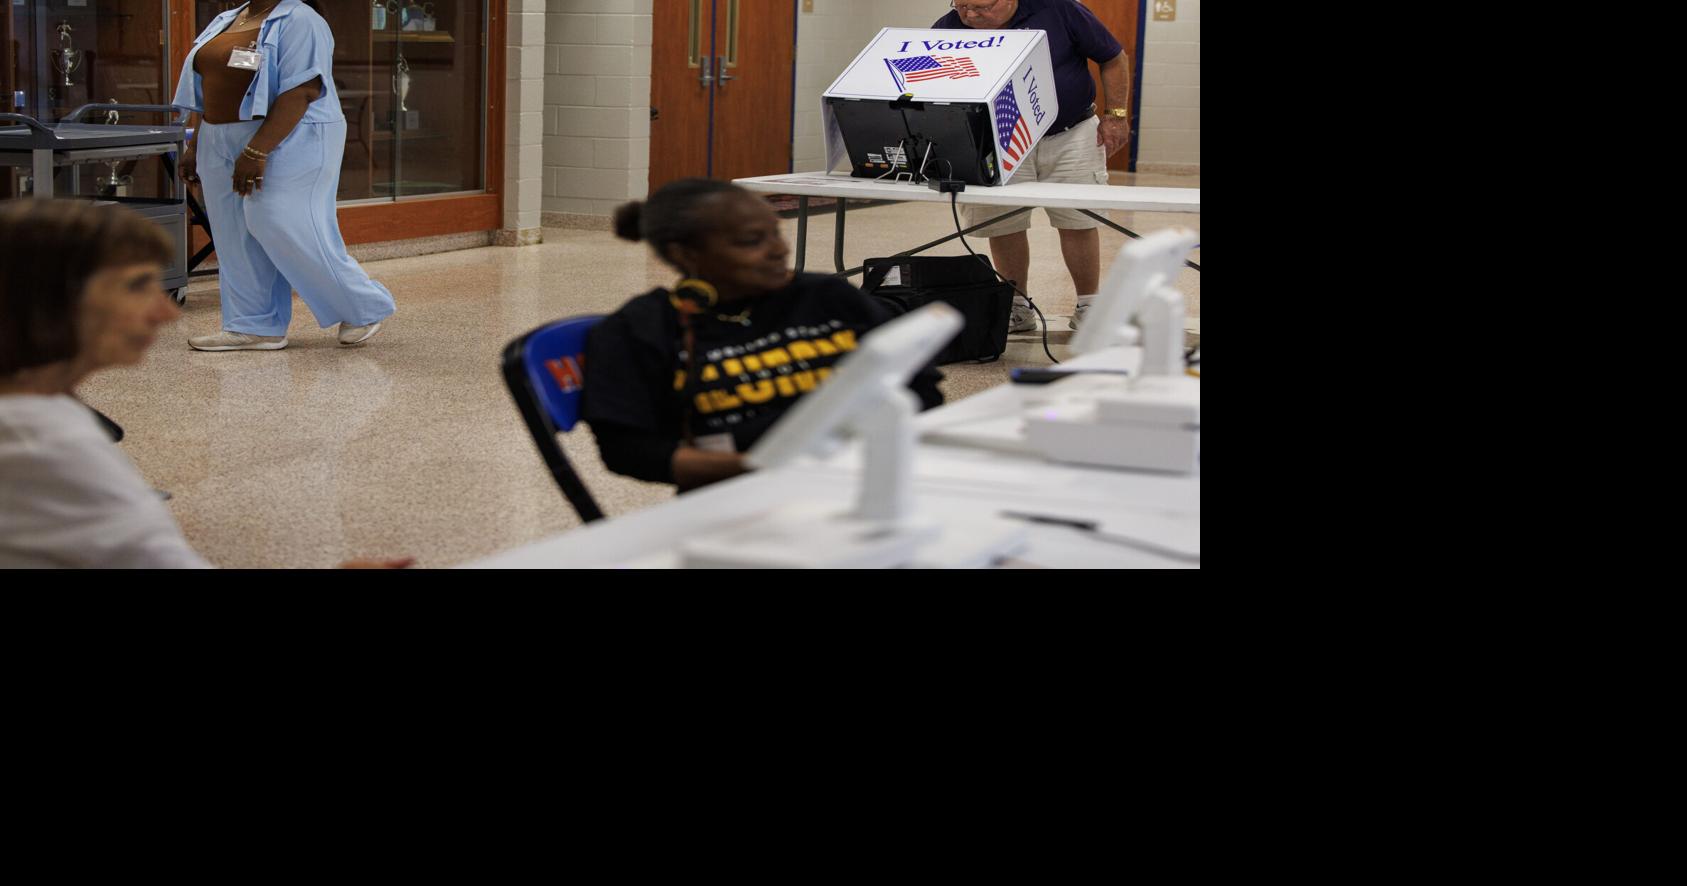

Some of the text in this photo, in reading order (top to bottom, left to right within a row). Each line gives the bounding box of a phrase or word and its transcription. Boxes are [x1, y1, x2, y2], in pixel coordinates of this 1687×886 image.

[897, 35, 1005, 53] I Voted!
[1023, 65, 1046, 126] I Voted
